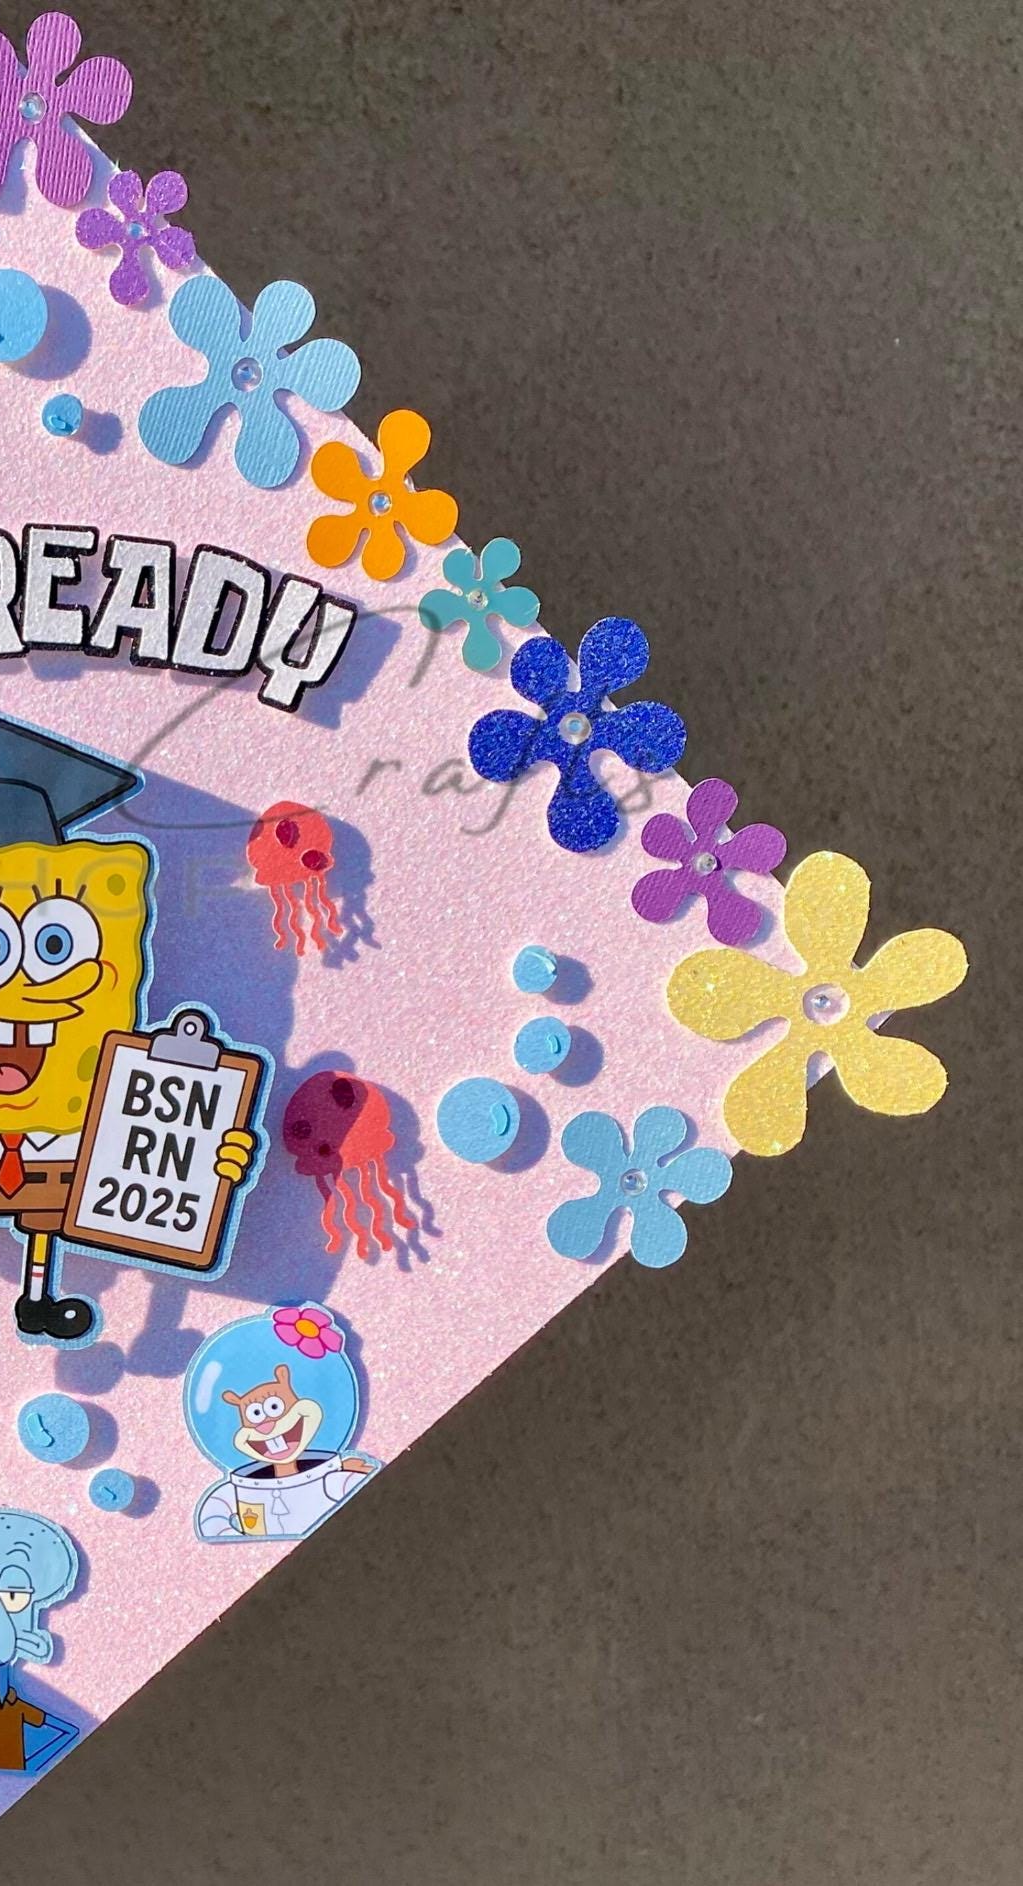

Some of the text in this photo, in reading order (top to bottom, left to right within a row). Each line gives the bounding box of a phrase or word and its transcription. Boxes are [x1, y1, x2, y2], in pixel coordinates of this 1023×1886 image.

[121, 1068, 222, 1131] BSN
[121, 1124, 196, 1182] RN
[91, 1176, 201, 1233] 2025
